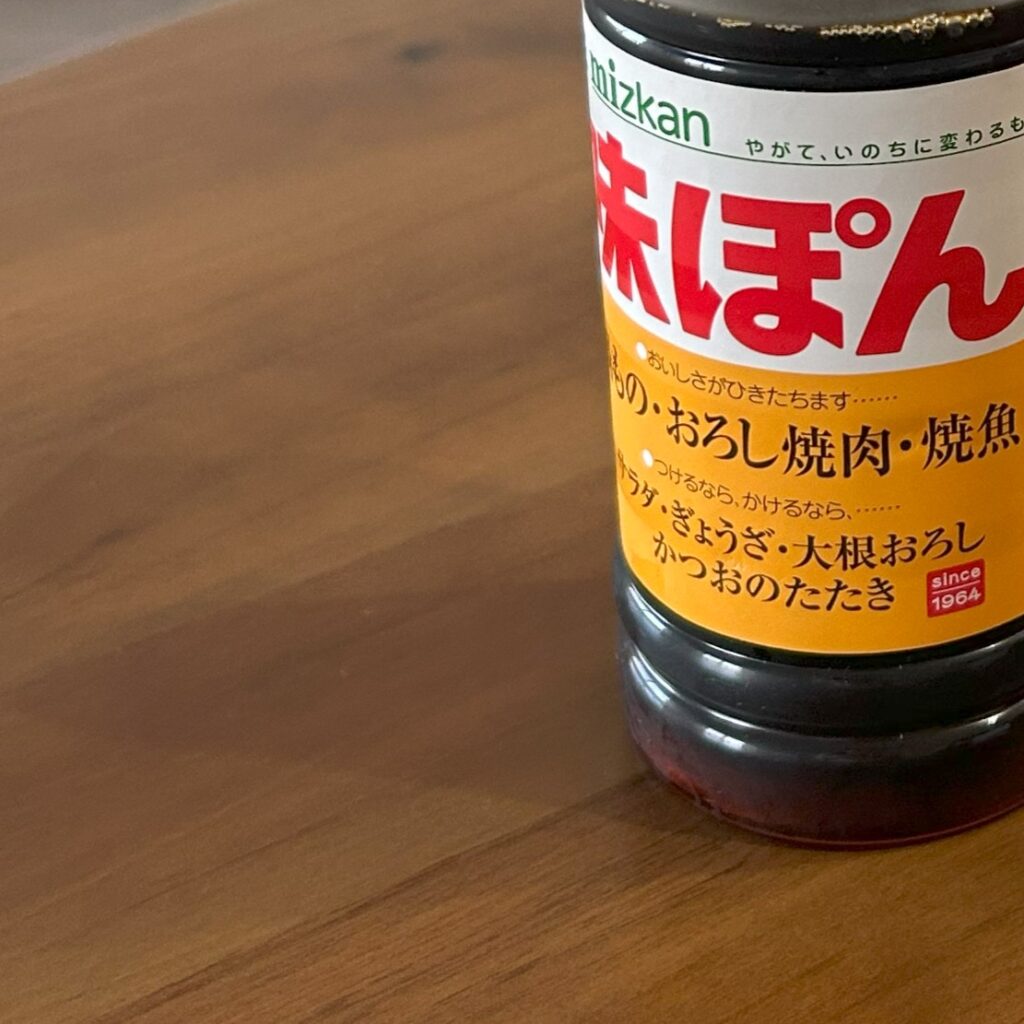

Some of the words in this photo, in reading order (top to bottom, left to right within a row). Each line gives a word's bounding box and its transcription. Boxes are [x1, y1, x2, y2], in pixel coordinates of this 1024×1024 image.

[589, 49, 711, 147] mizkan
[652, 530, 895, 612] かつおのたたき
[931, 566, 982, 589] since
[931, 586, 982, 611] 1964
